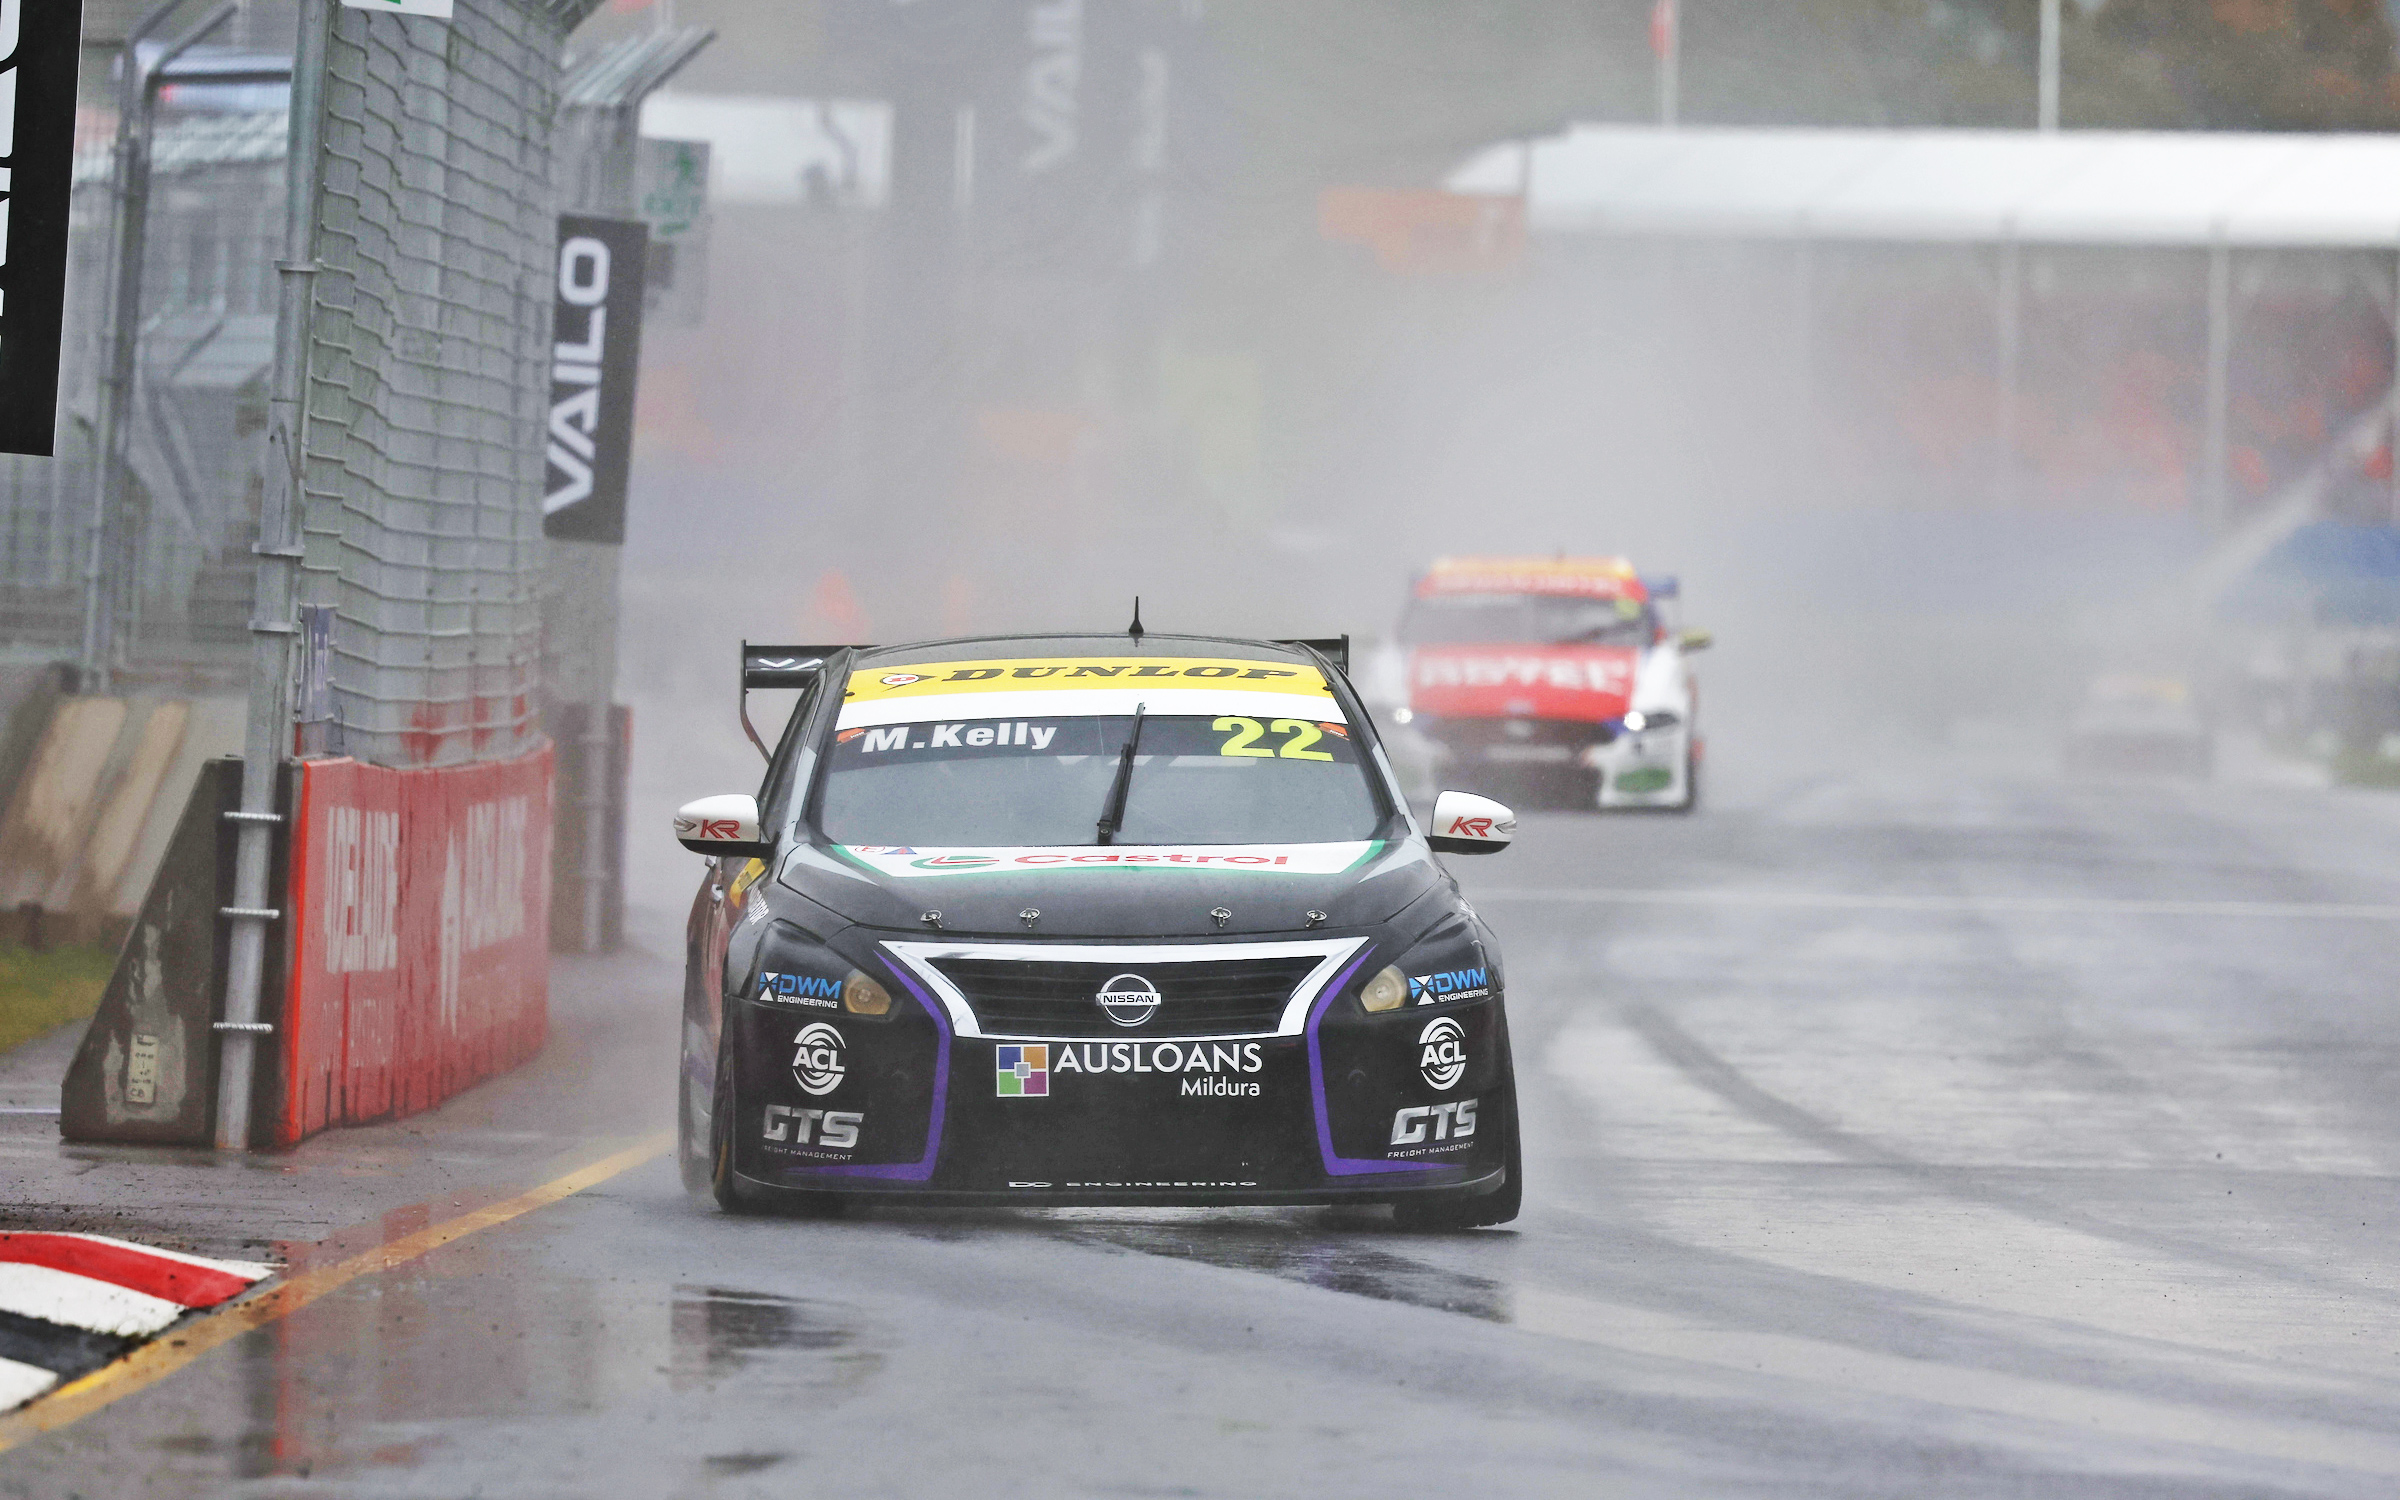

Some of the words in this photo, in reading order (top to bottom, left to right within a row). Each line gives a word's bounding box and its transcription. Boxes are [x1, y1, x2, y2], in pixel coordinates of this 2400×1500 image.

[542, 236, 611, 514] VAILO
[942, 666, 1298, 682] DUNLOP
[1212, 716, 1334, 761] 22
[700, 819, 740, 839] KR
[1448, 816, 1493, 838] KR
[1014, 853, 1289, 865] Castrol
[779, 974, 842, 999] DWM
[1435, 968, 1488, 993] DWM
[777, 994, 839, 1009] ENGINEERING
[1103, 994, 1155, 1004] NISSAN
[1438, 987, 1489, 1003] ENGINEERING
[792, 1046, 845, 1072] ACL
[1054, 1043, 1263, 1074] AUSLOANS
[1420, 1039, 1466, 1068] ACL
[1180, 1076, 1260, 1097] Mildura
[763, 1104, 864, 1148] GTS
[1391, 1098, 1478, 1145] GTS
[790, 1149, 852, 1161] MANAGEMENT
[1387, 1147, 1426, 1159] FREIGHT
[1428, 1141, 1474, 1154] MANAGEMENT
